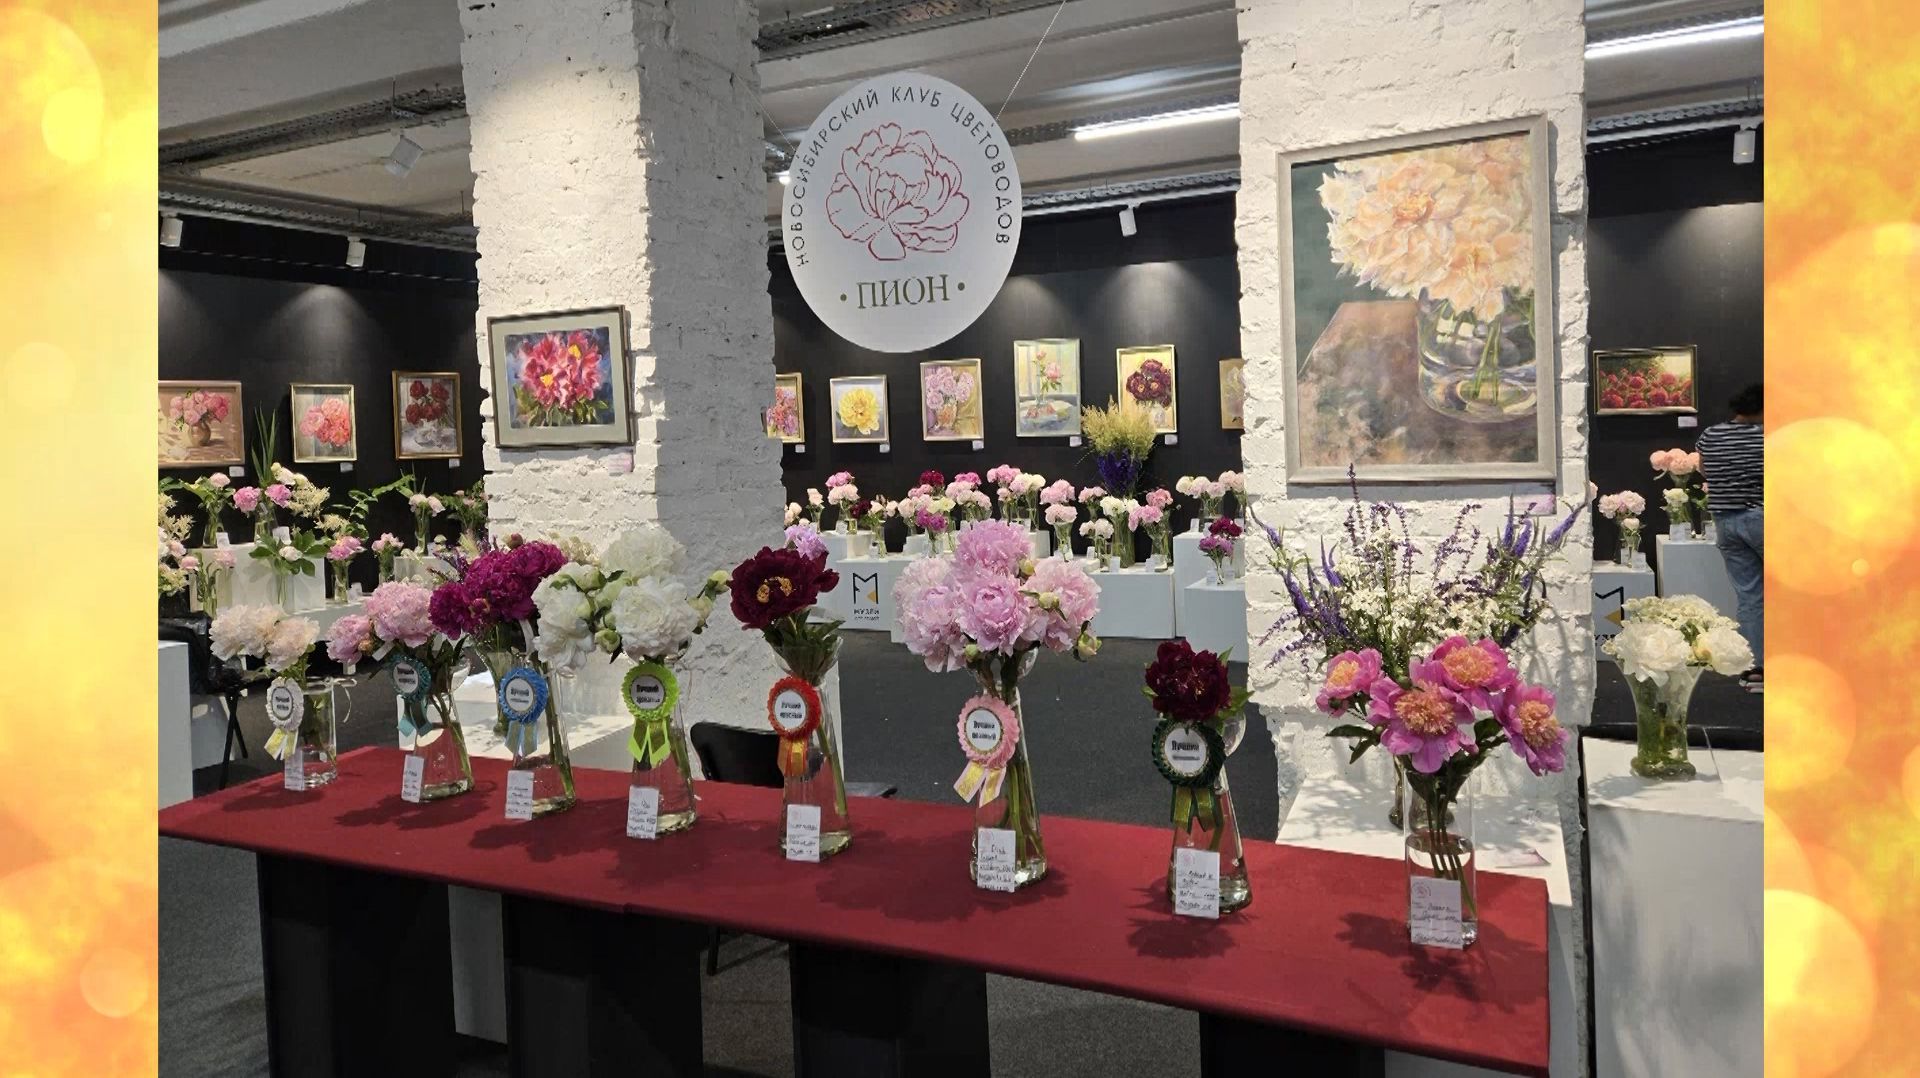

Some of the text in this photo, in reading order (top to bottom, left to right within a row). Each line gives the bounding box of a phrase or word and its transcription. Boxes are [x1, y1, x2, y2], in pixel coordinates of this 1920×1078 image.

[790, 86, 1013, 267] НОВОСИБИРСКИЙ КЛУБ ЦВЕТОВОДОВ
[856, 274, 951, 309] ПИОН
